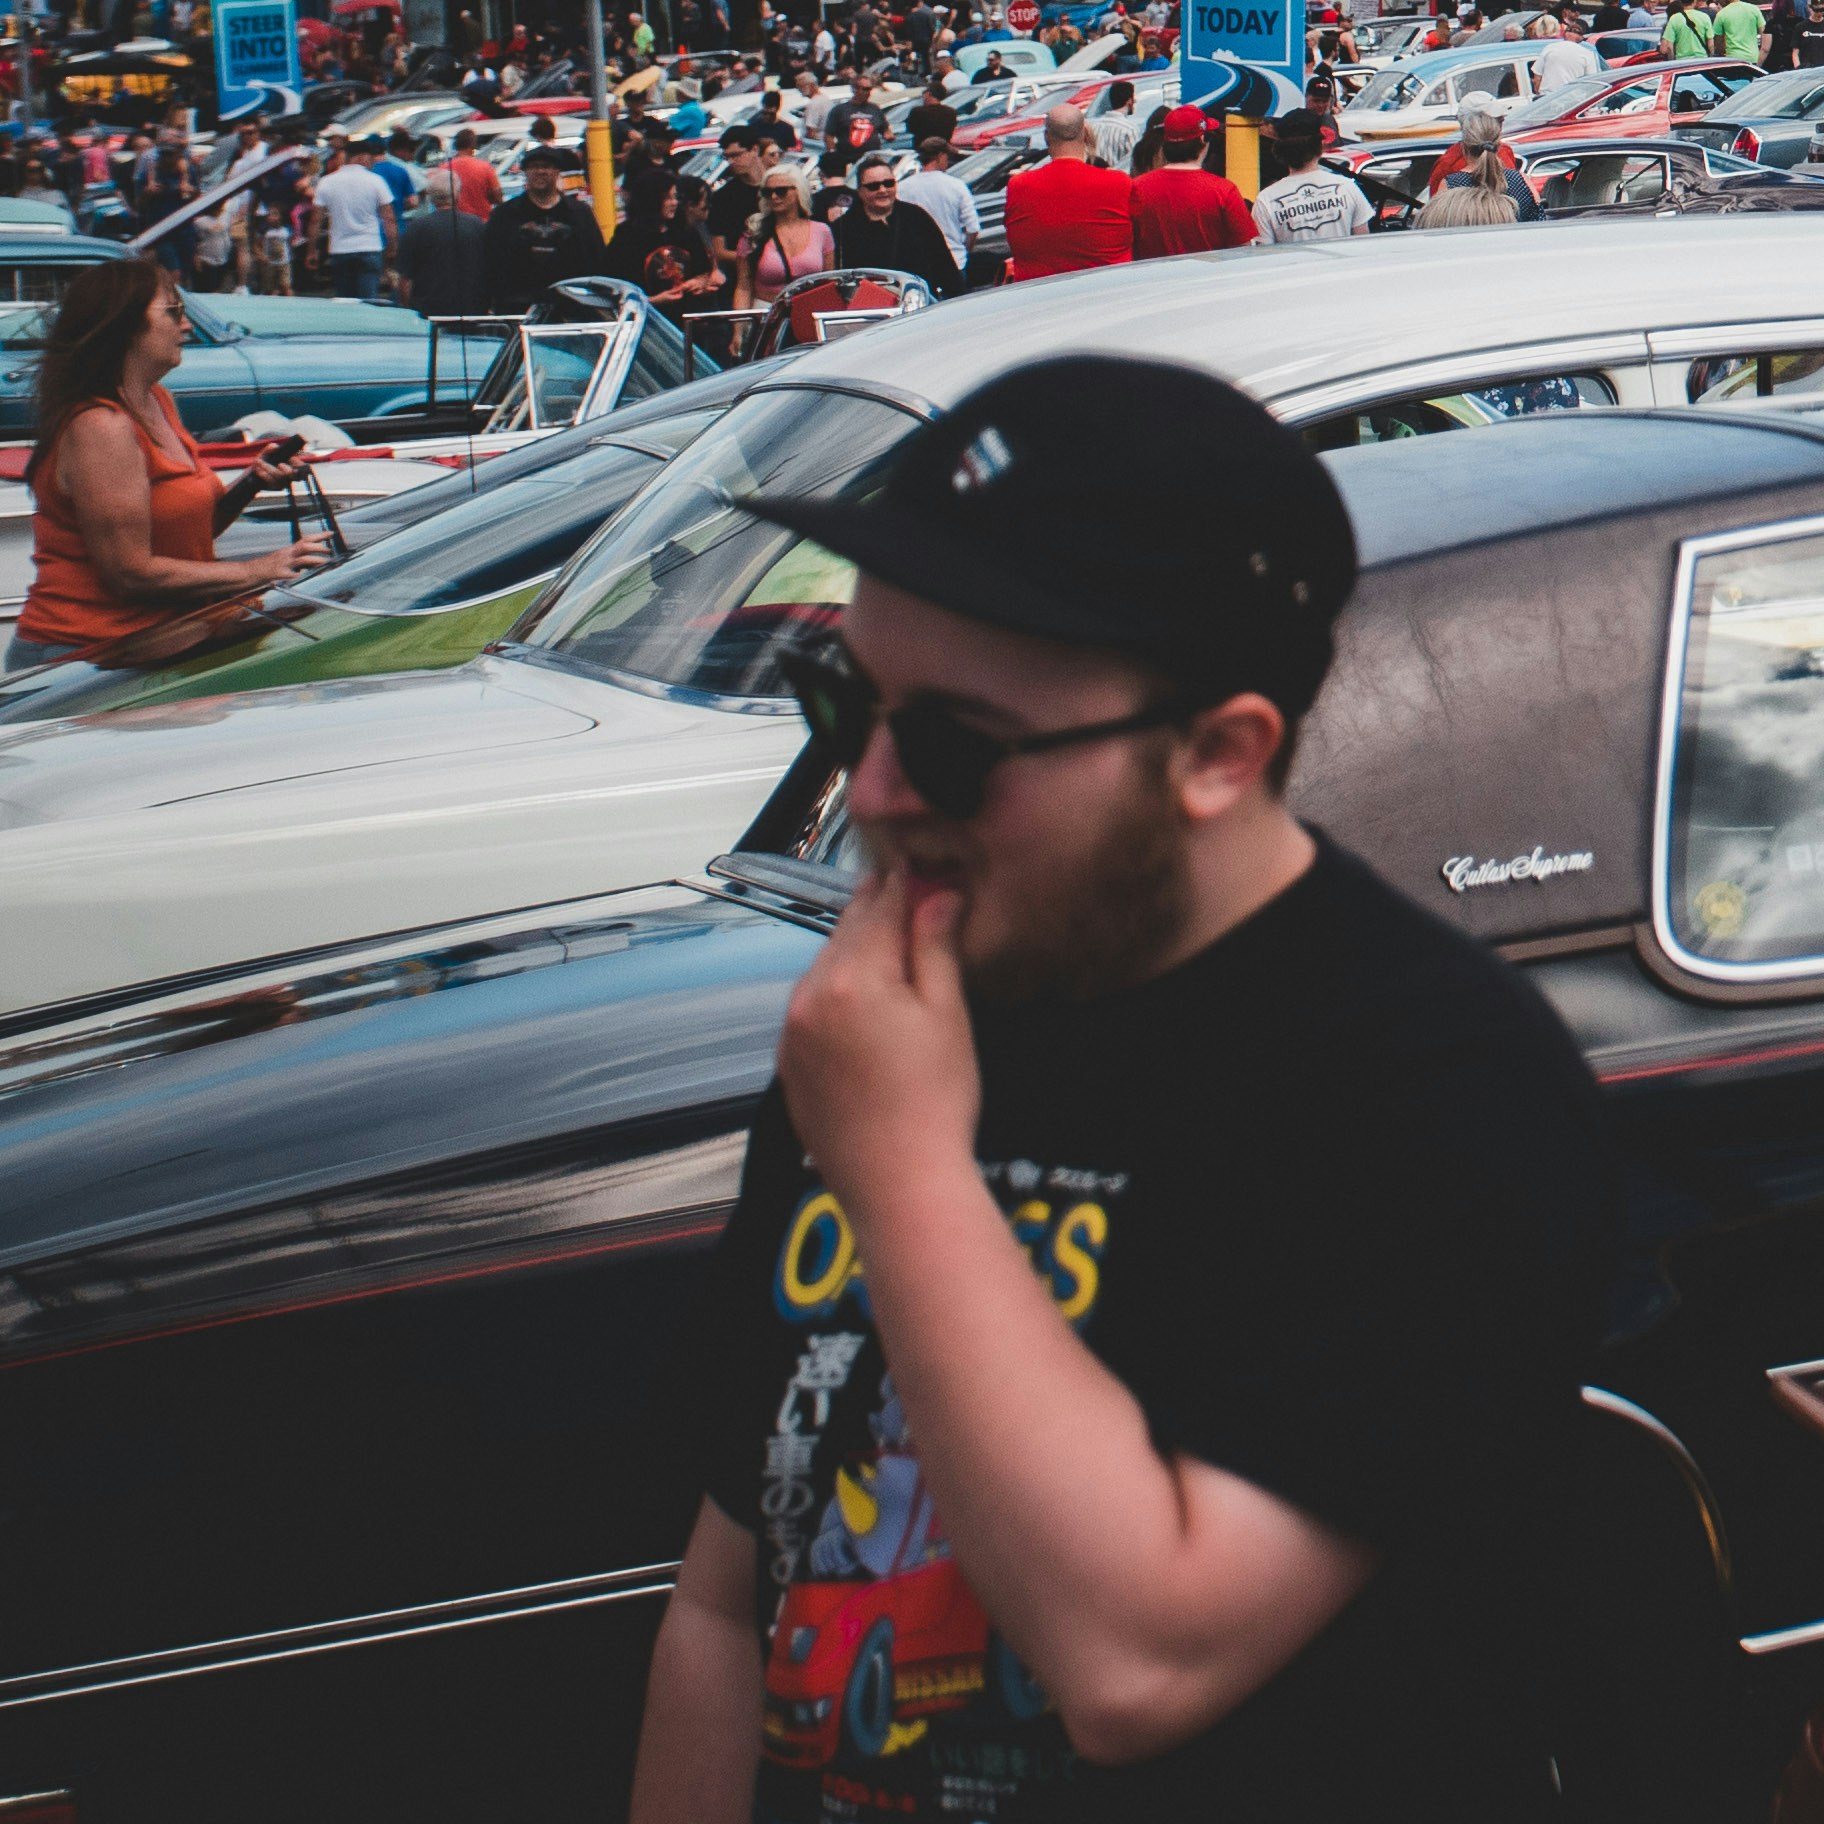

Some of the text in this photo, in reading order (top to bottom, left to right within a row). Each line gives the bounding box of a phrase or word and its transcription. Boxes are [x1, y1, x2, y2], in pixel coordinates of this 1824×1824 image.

[228, 15, 284, 35] STEER
[1010, 7, 1039, 23] STOP
[1196, 6, 1279, 35] TODAY
[230, 37, 286, 60] INTO
[1442, 845, 1594, 892] Cutlass Supreme
